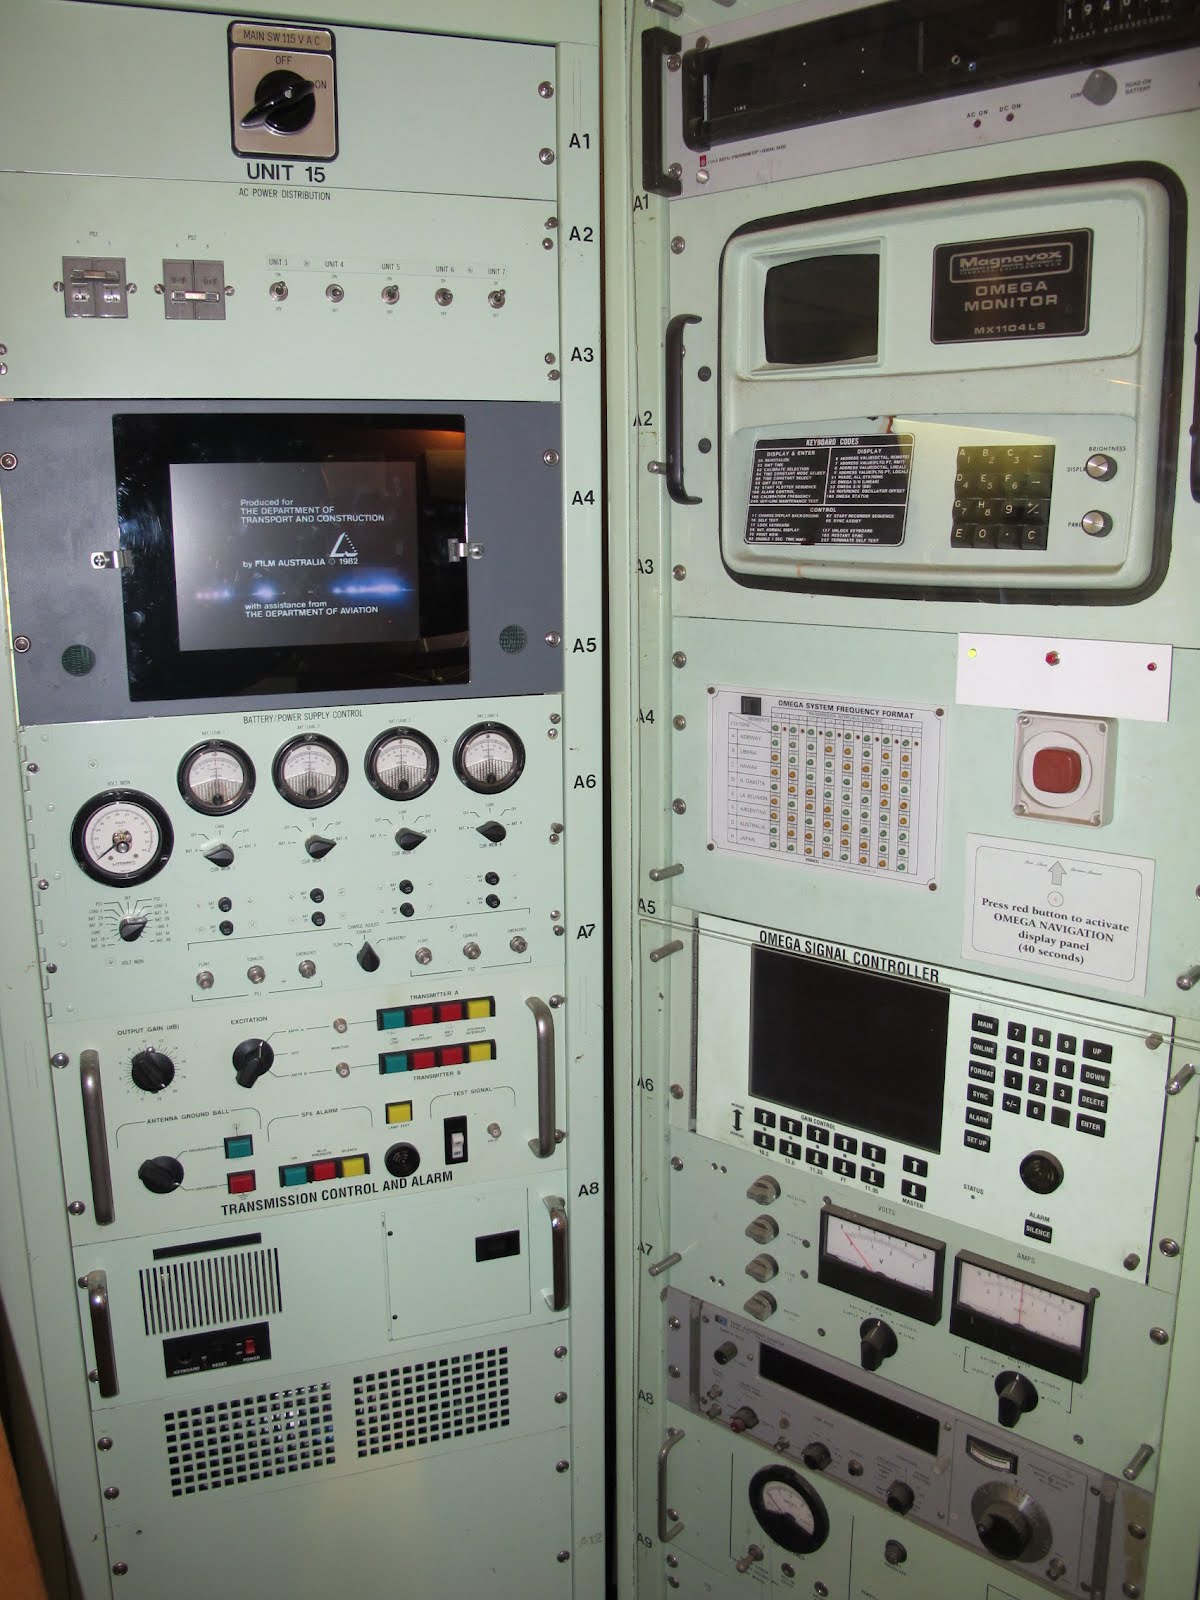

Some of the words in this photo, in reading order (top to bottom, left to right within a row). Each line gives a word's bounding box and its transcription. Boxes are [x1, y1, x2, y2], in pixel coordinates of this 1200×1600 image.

[243, 30, 264, 41] MAIN
[268, 32, 279, 41] SW
[283, 34, 296, 43] 115
[298, 35, 304, 44] V
[307, 36, 312, 44] A
[314, 37, 320, 45] C
[276, 56, 292, 64] OFF
[315, 80, 326, 89] ON
[569, 133, 590, 150] A1
[247, 163, 294, 181] UNIT
[305, 167, 325, 182] 15
[239, 188, 248, 196] AC
[253, 189, 277, 198] POWER
[282, 190, 331, 200] DISTRIBUTION
[633, 193, 649, 211] A1
[569, 227, 593, 242] A2
[960, 251, 1062, 268] Magnavox
[976, 281, 1048, 296] OMEGA
[964, 295, 1058, 312] MONITOR
[974, 322, 1046, 335] MX1104LS
[570, 347, 594, 363] A3
[633, 410, 652, 427] A2
[572, 490, 595, 505] A4
[261, 506, 320, 514] DEPARTMENT
[316, 514, 385, 522] CONSTRUCTION
[243, 561, 252, 569] by
[245, 602, 262, 610] with
[266, 609, 323, 618] DEPARTMENT
[340, 606, 378, 614] AVIATION
[573, 638, 597, 653] A5
[778, 700, 803, 708] OMEGA
[806, 703, 833, 711] SYSTEM
[837, 706, 879, 715] FREQUENCY
[882, 710, 914, 719] FORMAT
[243, 714, 301, 724] BATTERY/POWER
[304, 712, 329, 721] SUPPLY
[332, 709, 363, 718] CONTROL
[636, 708, 654, 724] A4
[573, 774, 596, 789] A6
[746, 778, 765, 786] DAKOTA
[740, 806, 766, 815] ARGENTINA
[740, 821, 765, 829] AUSTRALIA
[637, 897, 655, 915] A5
[982, 897, 1009, 910] Press
[1012, 904, 1029, 914] red
[1032, 906, 1068, 921] button
[1071, 914, 1083, 923] to
[1085, 918, 1130, 932] activate
[577, 923, 595, 940] A7
[994, 912, 1036, 928] OMEGA
[1039, 921, 1114, 943] NAVIGATION
[1018, 931, 1056, 946] display
[1059, 938, 1090, 951] panel
[759, 930, 801, 951] OMEGA
[805, 941, 848, 962] SIGNAL
[853, 952, 939, 983] CONTROLLER
[1018, 944, 1035, 954] (40
[1038, 947, 1085, 965] seconds)
[410, 991, 452, 1001] TRANSMITTER
[231, 1016, 268, 1025] EXCITATION
[977, 1020, 994, 1029] MAIN
[117, 1028, 143, 1036] OUTPUT
[1014, 1028, 1019, 1036] 7
[1039, 1034, 1044, 1042] 8
[973, 1044, 994, 1053] ONLINE
[1037, 1058, 1042, 1066] 5
[970, 1067, 994, 1078] FORMAT
[1062, 1065, 1067, 1073] 6
[413, 1072, 454, 1081] TRANSMITTER
[1085, 1071, 1106, 1082] DOWN
[637, 1077, 653, 1091] A6
[471, 1087, 492, 1095] SIGNAL
[973, 1090, 989, 1100] SYNC
[1082, 1096, 1105, 1107] DELETE
[147, 1115, 178, 1124] ANTENNA
[181, 1112, 210, 1120] GROUND
[969, 1114, 989, 1124] ALARM
[814, 1119, 835, 1130] CONTROL
[1081, 1120, 1101, 1130] ENTER
[967, 1136, 977, 1144] SET
[978, 1138, 987, 1146] UP
[221, 1192, 317, 1216] TRANSMISSION
[321, 1183, 378, 1201] CONTROL
[383, 1178, 407, 1192] AND
[411, 1171, 453, 1187] ALARM
[578, 1182, 599, 1197] A8
[963, 1184, 984, 1195] STATUS
[902, 1198, 924, 1209] MASTER
[878, 1206, 895, 1216] VOLTS
[1029, 1212, 1050, 1222] ALARM
[1026, 1225, 1050, 1238] SILENCE
[637, 1241, 652, 1255] A7
[1017, 1253, 1036, 1264] AMPS
[638, 1389, 653, 1405] A8
[637, 1532, 652, 1548] A9
